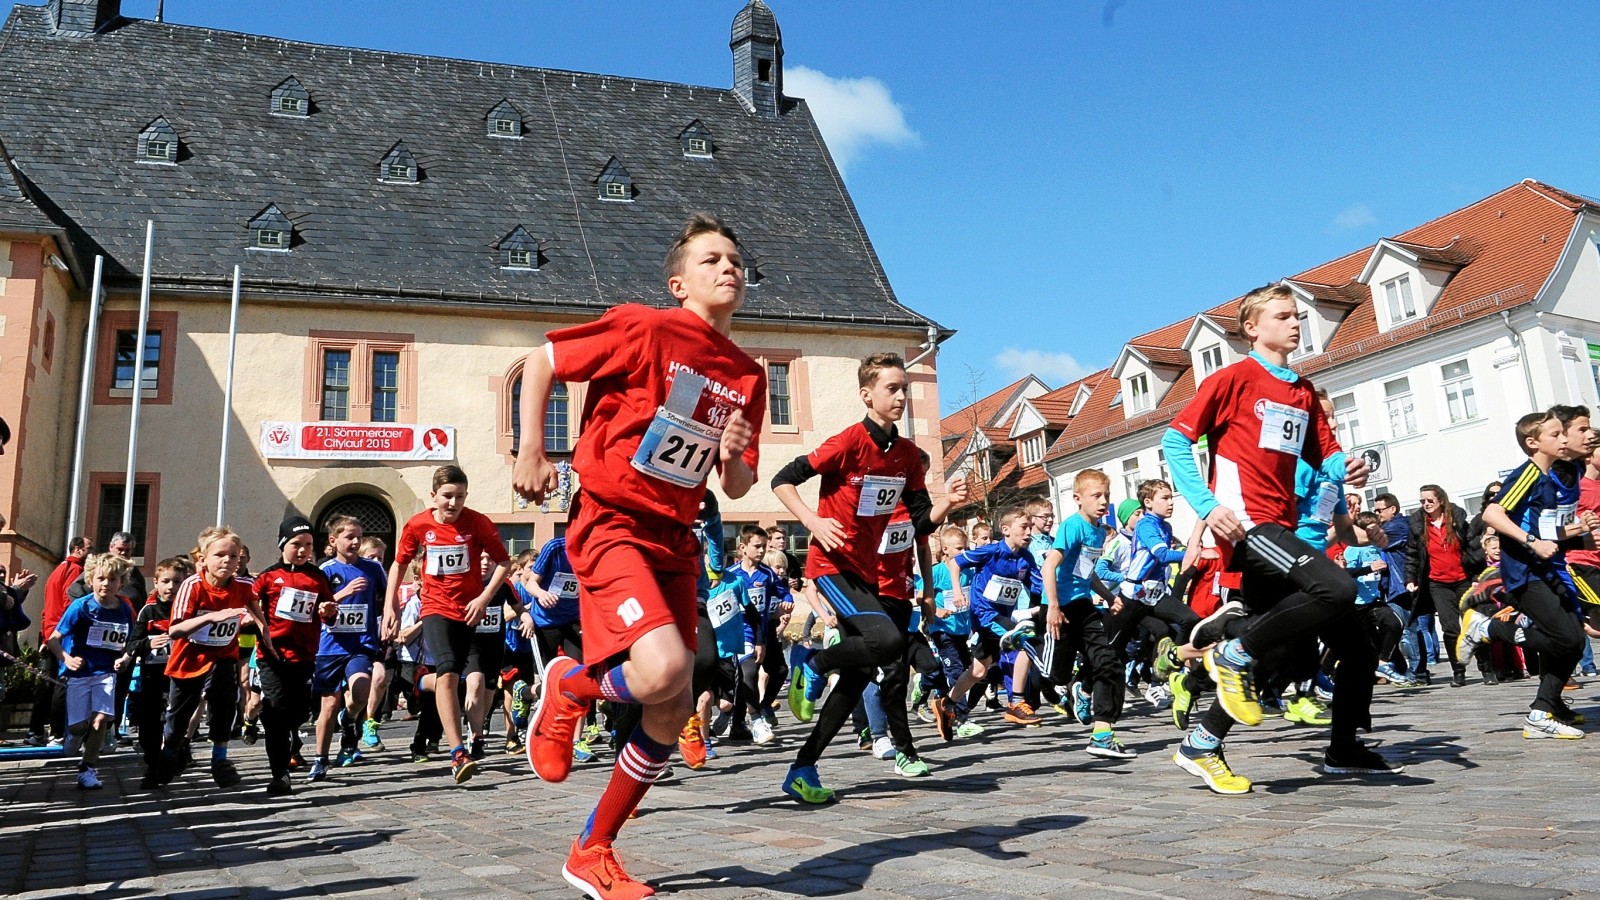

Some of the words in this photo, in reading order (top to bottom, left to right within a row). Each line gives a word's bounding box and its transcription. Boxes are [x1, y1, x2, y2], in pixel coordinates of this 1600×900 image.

[668, 361, 746, 406] HONBACH
[316, 427, 331, 437] 21.
[334, 427, 403, 438] Sömmerdaer
[1282, 420, 1301, 443] 91
[324, 438, 363, 449] Citylauf
[366, 438, 391, 448] 2015
[659, 435, 712, 473] 211
[876, 488, 897, 506] 92
[889, 530, 908, 545] 84
[438, 553, 464, 568] 167
[562, 580, 578, 593] 85
[291, 598, 314, 615] 213
[616, 596, 644, 628] 10
[715, 600, 732, 617] 25
[340, 612, 364, 626] 162
[208, 621, 238, 638] 208
[101, 629, 127, 648] 108
